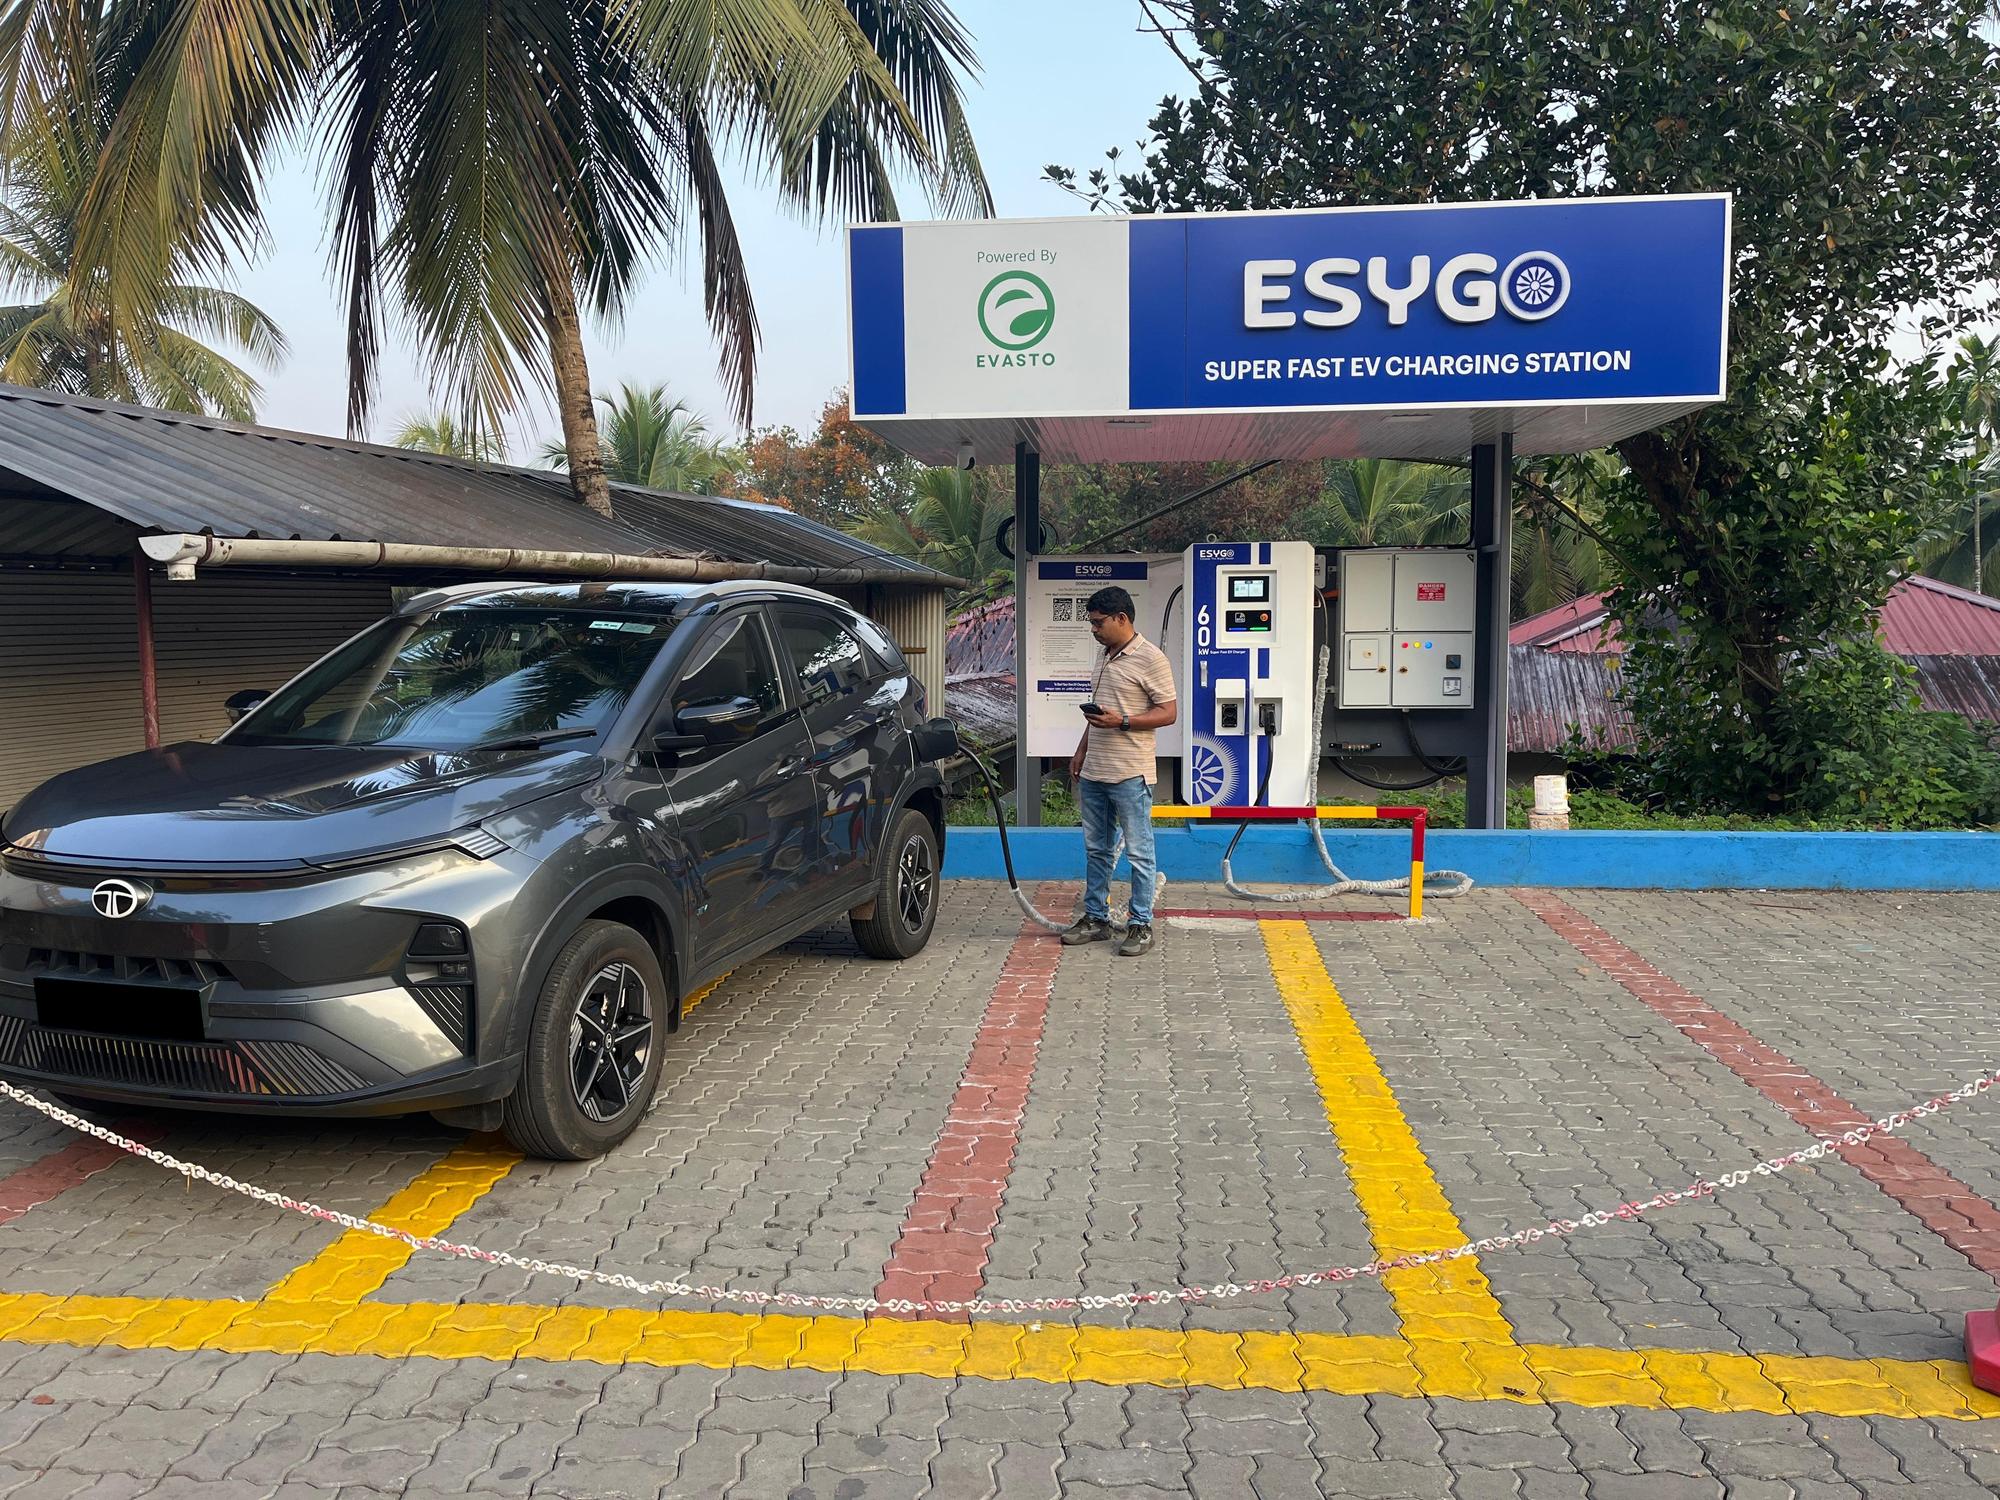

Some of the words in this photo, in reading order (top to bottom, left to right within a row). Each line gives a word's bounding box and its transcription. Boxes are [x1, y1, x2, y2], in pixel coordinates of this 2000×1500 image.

[977, 249, 1036, 263] Powered
[1040, 249, 1057, 264] By
[1243, 250, 1571, 328] ESYGO
[976, 353, 1055, 367] EVASTO
[1205, 360, 1281, 381] SUPER
[1288, 358, 1345, 378] FAST
[1350, 356, 1381, 377] EV
[1385, 353, 1520, 376] CHARGING
[1524, 350, 1631, 373] STATION
[1200, 549, 1235, 557] ESYGO
[1075, 566, 1112, 574] ESYGO
